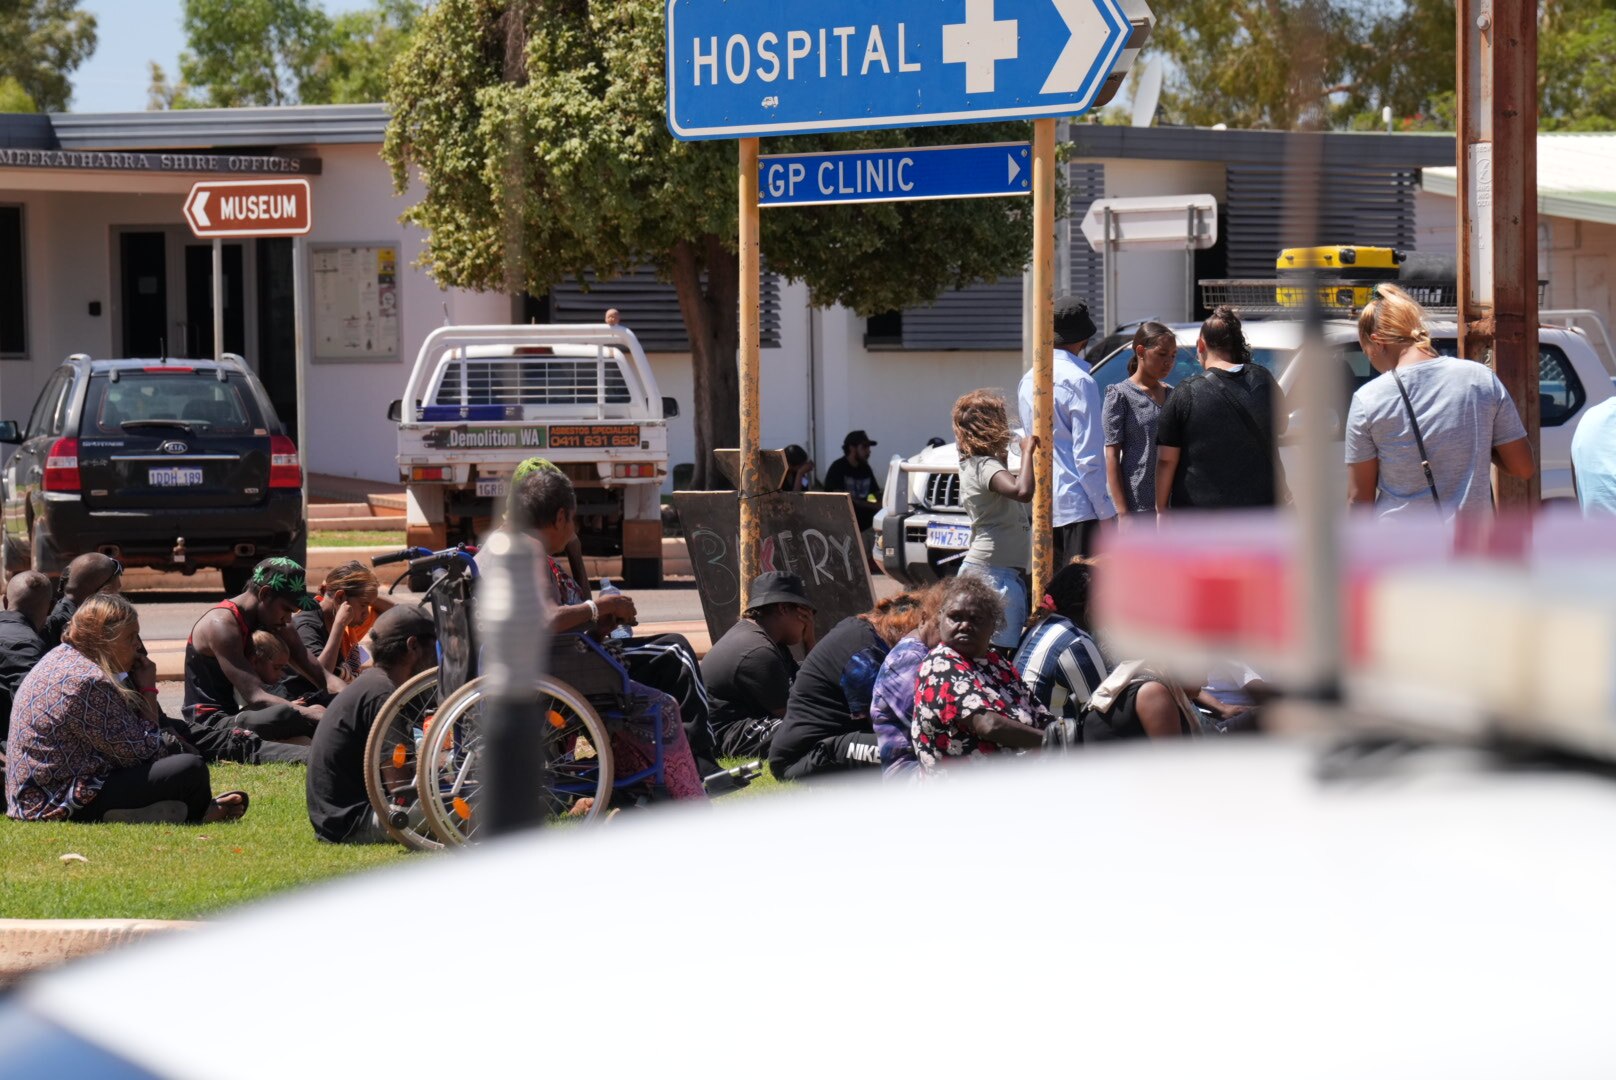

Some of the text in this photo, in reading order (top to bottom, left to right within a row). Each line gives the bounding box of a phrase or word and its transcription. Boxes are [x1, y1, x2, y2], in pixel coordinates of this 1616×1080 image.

[693, 22, 922, 86] HOSPITAL
[0, 150, 301, 172] MEEKATHARRA SHIRE OFFICES
[768, 157, 915, 198] GP CLINIC
[220, 195, 297, 220] MUSEUM
[168, 444, 183, 452] KIA
[450, 428, 540, 447] Demolition WA
[551, 435, 638, 446] 0411 631 620
[846, 742, 881, 764] NIKE
